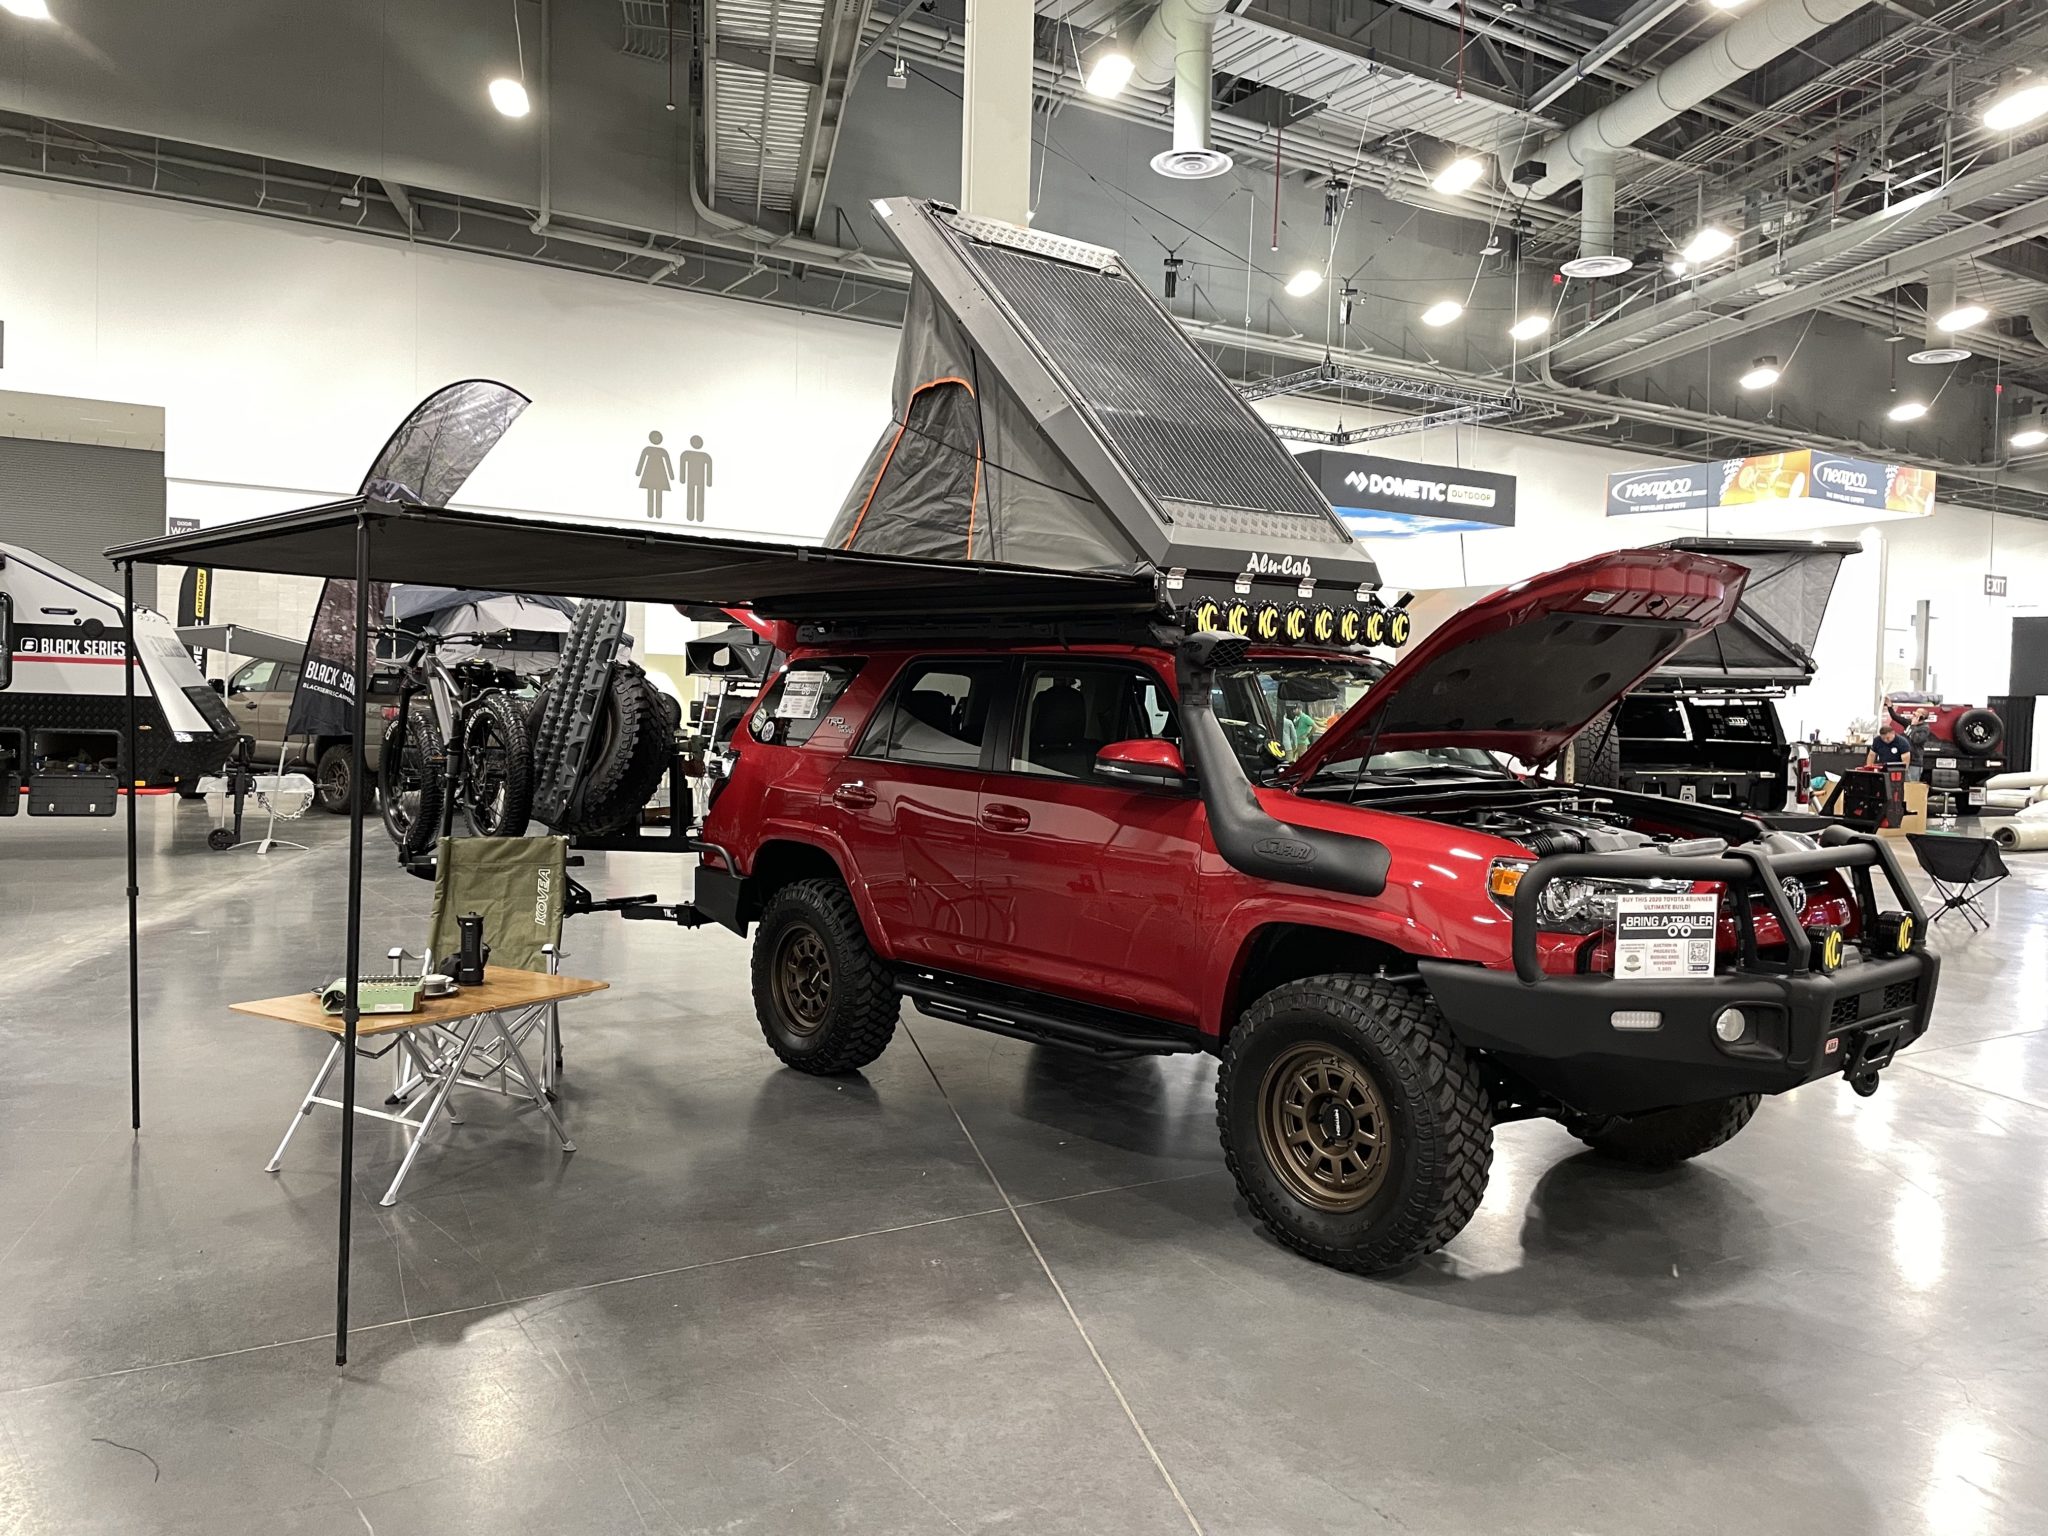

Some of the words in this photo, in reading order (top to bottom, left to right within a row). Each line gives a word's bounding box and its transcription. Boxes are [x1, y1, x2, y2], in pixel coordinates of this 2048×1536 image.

[1368, 473, 1447, 502] DOMETIC
[1451, 489, 1492, 501] OUTDOOR
[1624, 478, 1692, 501] neapco
[1822, 467, 1868, 490] neapco
[1246, 552, 1311, 577] Alu-Cab
[197, 572, 205, 614] OUTDOOR
[1986, 578, 2006, 594] EXIT
[1197, 602, 1218, 632] KC
[1228, 604, 1249, 636] KC
[1258, 606, 1278, 639] KC
[1287, 607, 1306, 640] KC
[1314, 608, 1333, 641] KC
[1341, 610, 1359, 642] KC
[1366, 611, 1384, 642] KC
[1391, 613, 1409, 643] KC
[41, 638, 82, 655] BLACK
[84, 640, 126, 657] SERIES
[305, 660, 341, 687] BLACK
[825, 716, 845, 726] TRD
[1259, 840, 1312, 860] SAFARI
[535, 868, 551, 926] KOVEA
[1626, 915, 1659, 927] BRING
[1661, 915, 1669, 926] A
[1670, 915, 1714, 926] TRAILER
[1898, 916, 1913, 952] KC
[1824, 930, 1841, 969] KC
